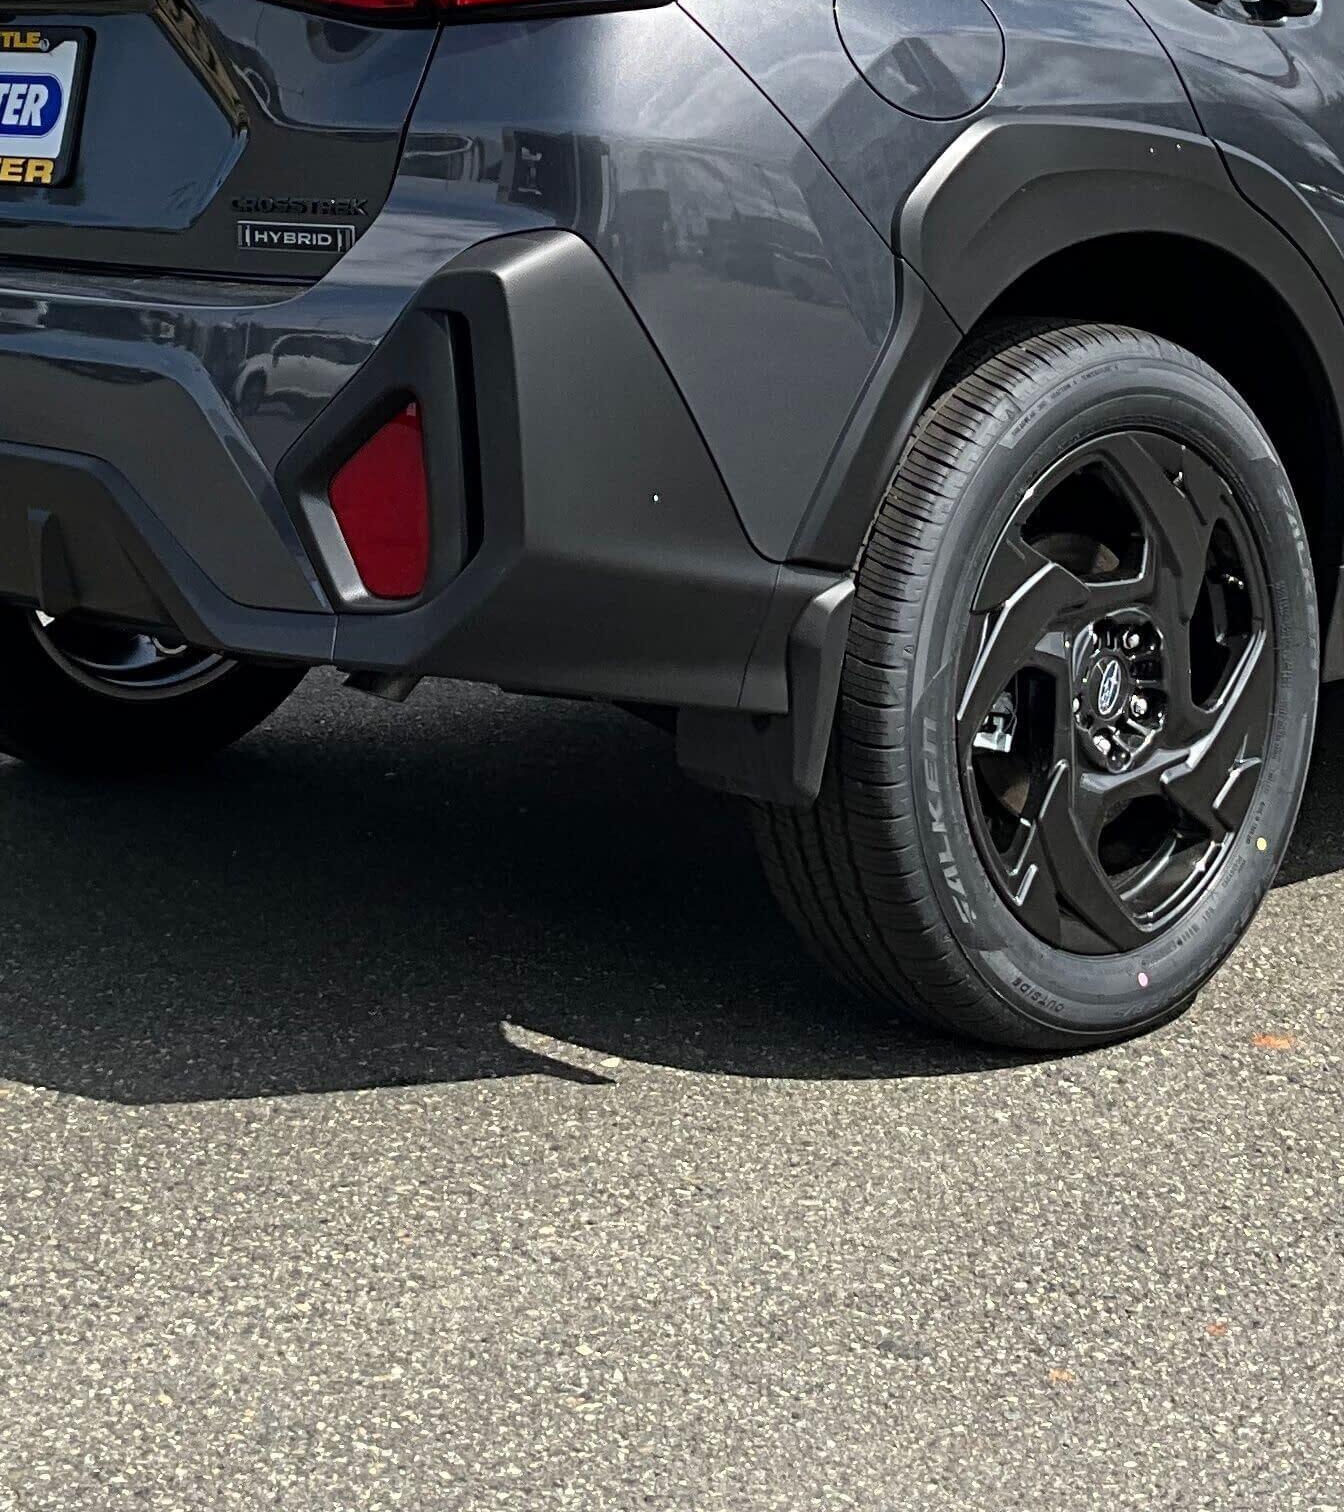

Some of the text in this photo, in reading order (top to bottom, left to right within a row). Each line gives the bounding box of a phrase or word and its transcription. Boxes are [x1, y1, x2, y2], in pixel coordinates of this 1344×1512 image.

[230, 197, 369, 217] CROSSTREK
[254, 230, 333, 247] HYBRID
[1011, 976, 1065, 1012] OUTSIDE
